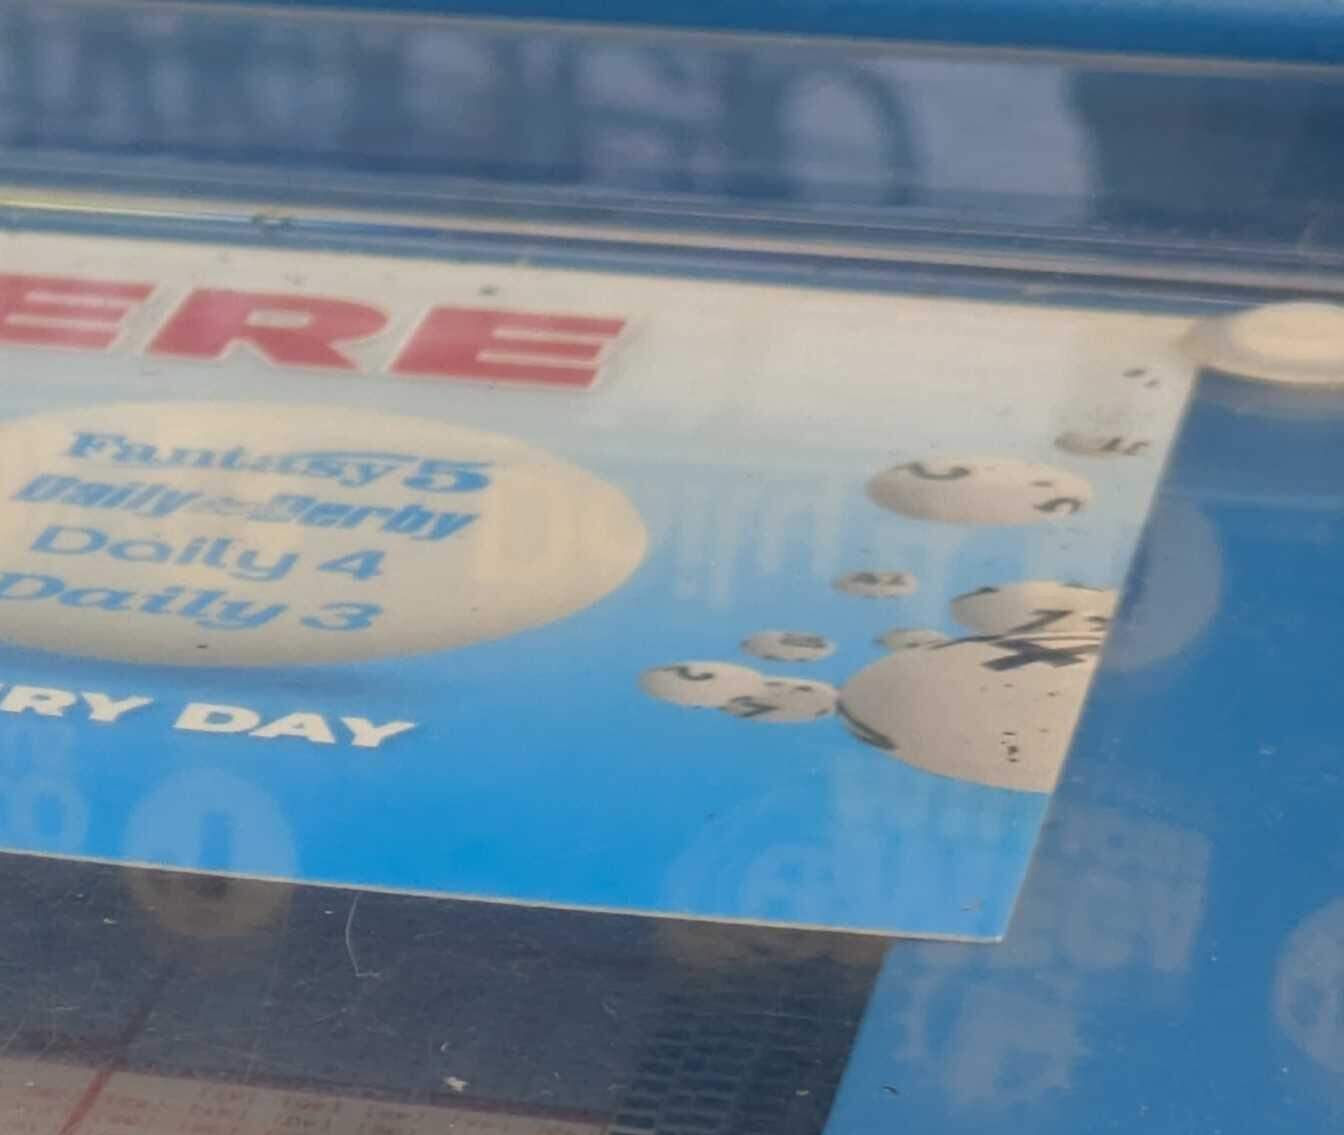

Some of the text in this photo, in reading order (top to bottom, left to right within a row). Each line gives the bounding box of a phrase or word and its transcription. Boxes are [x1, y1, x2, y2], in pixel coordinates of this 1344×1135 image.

[64, 431, 496, 494] Fantasy 5
[10, 473, 481, 541] Daily Derby
[29, 524, 387, 582] Daily 4
[301, 602, 384, 632] 3
[173, 702, 419, 750] DAY
